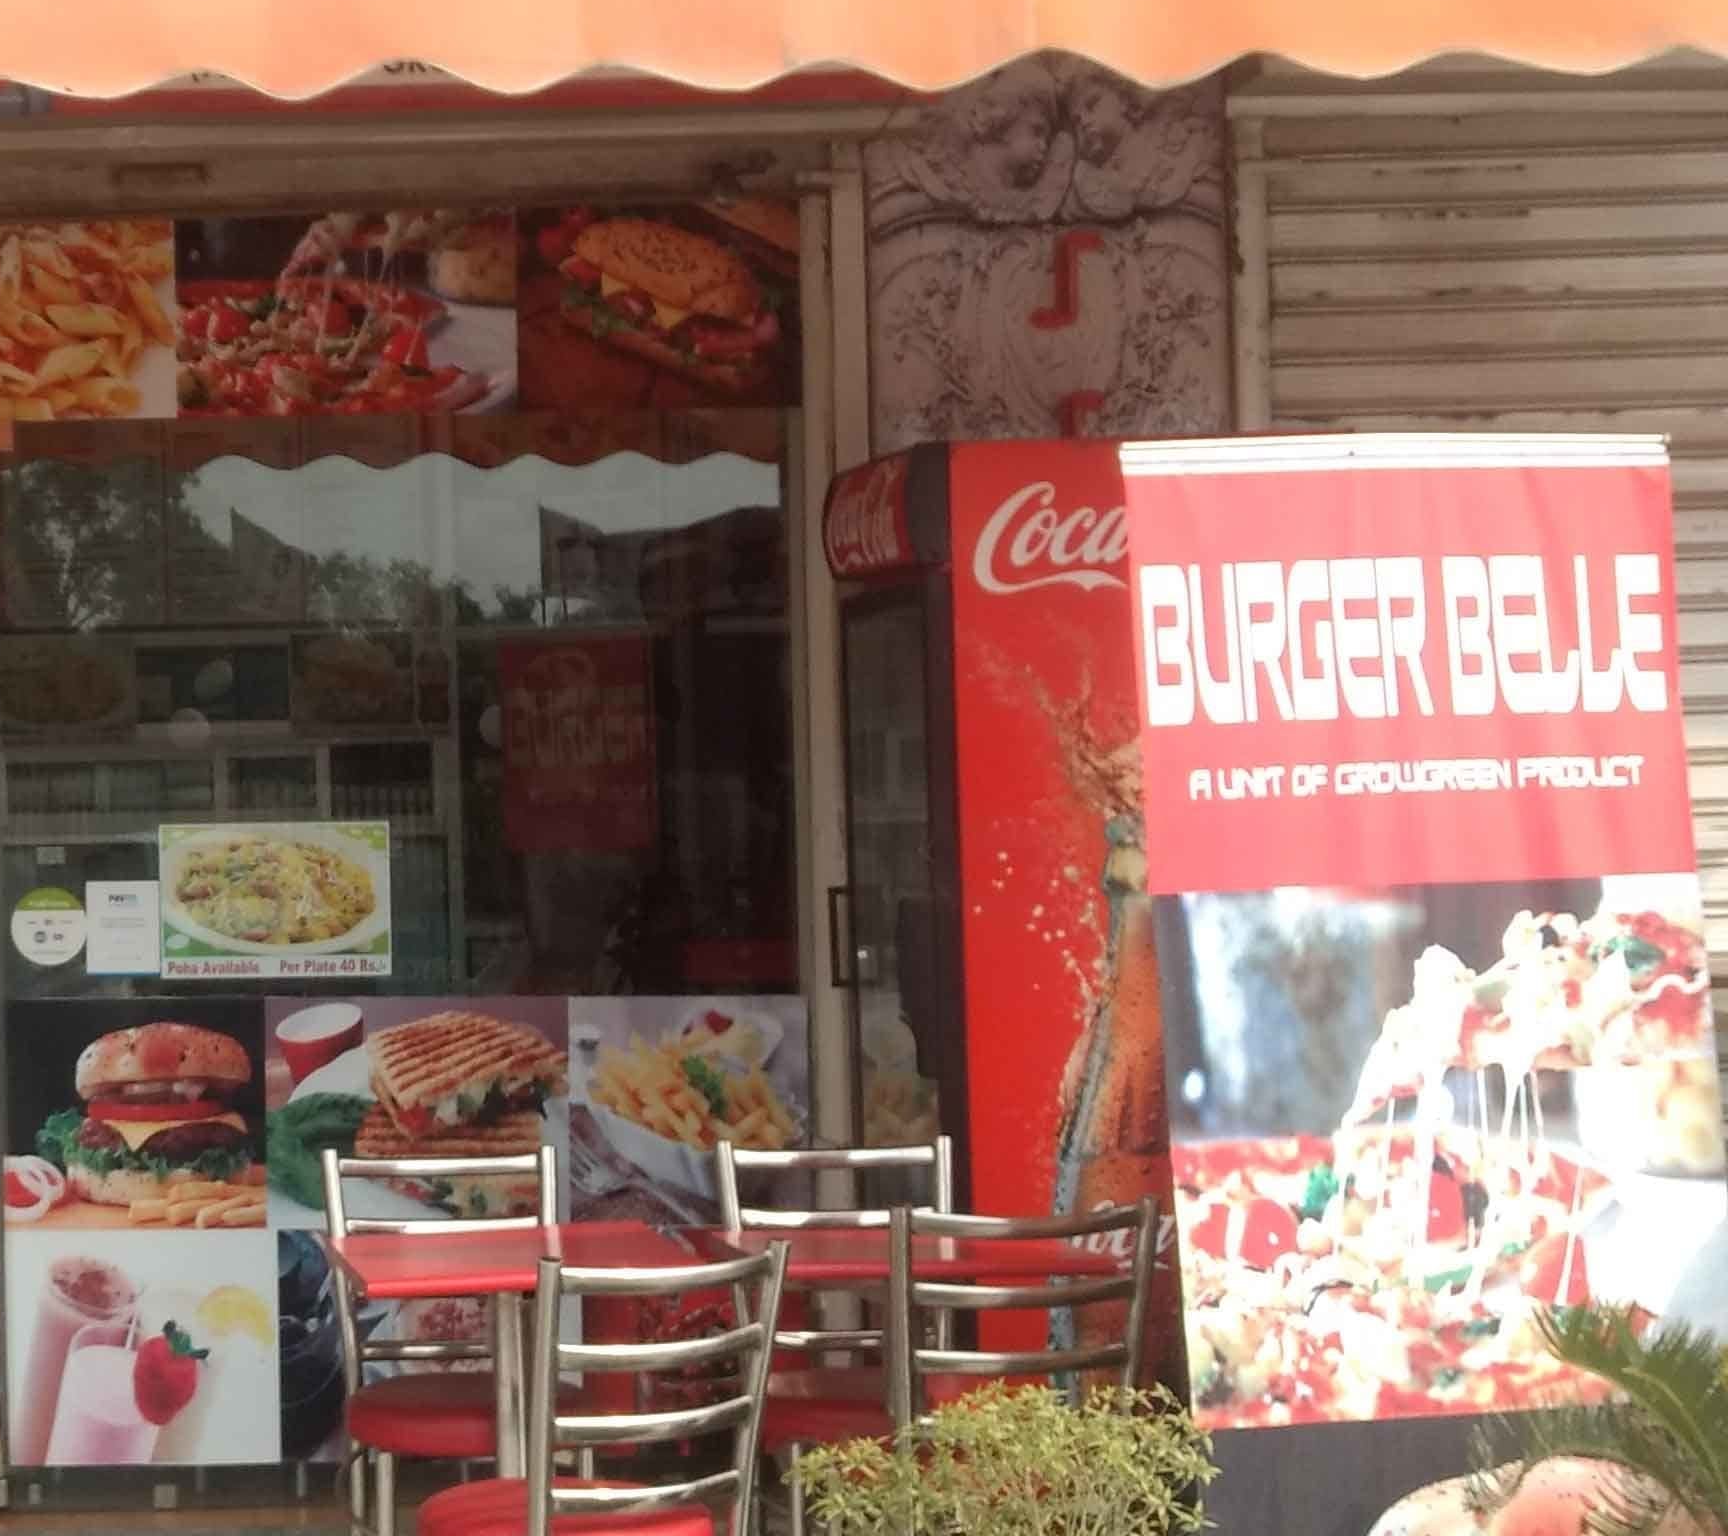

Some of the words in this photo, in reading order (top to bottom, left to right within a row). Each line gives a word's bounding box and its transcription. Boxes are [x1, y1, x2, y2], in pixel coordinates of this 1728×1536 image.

[1139, 555, 1436, 727] BURGER
[1440, 553, 1669, 716] BELLE
[1187, 767, 1213, 801] A
[1218, 765, 1287, 800] UNIT
[1291, 763, 1330, 797] OF
[1516, 754, 1647, 790] PRODUCT
[202, 959, 261, 975] Available
[280, 959, 300, 973] Per
[303, 958, 337, 973] Plate
[340, 958, 357, 972] 40
